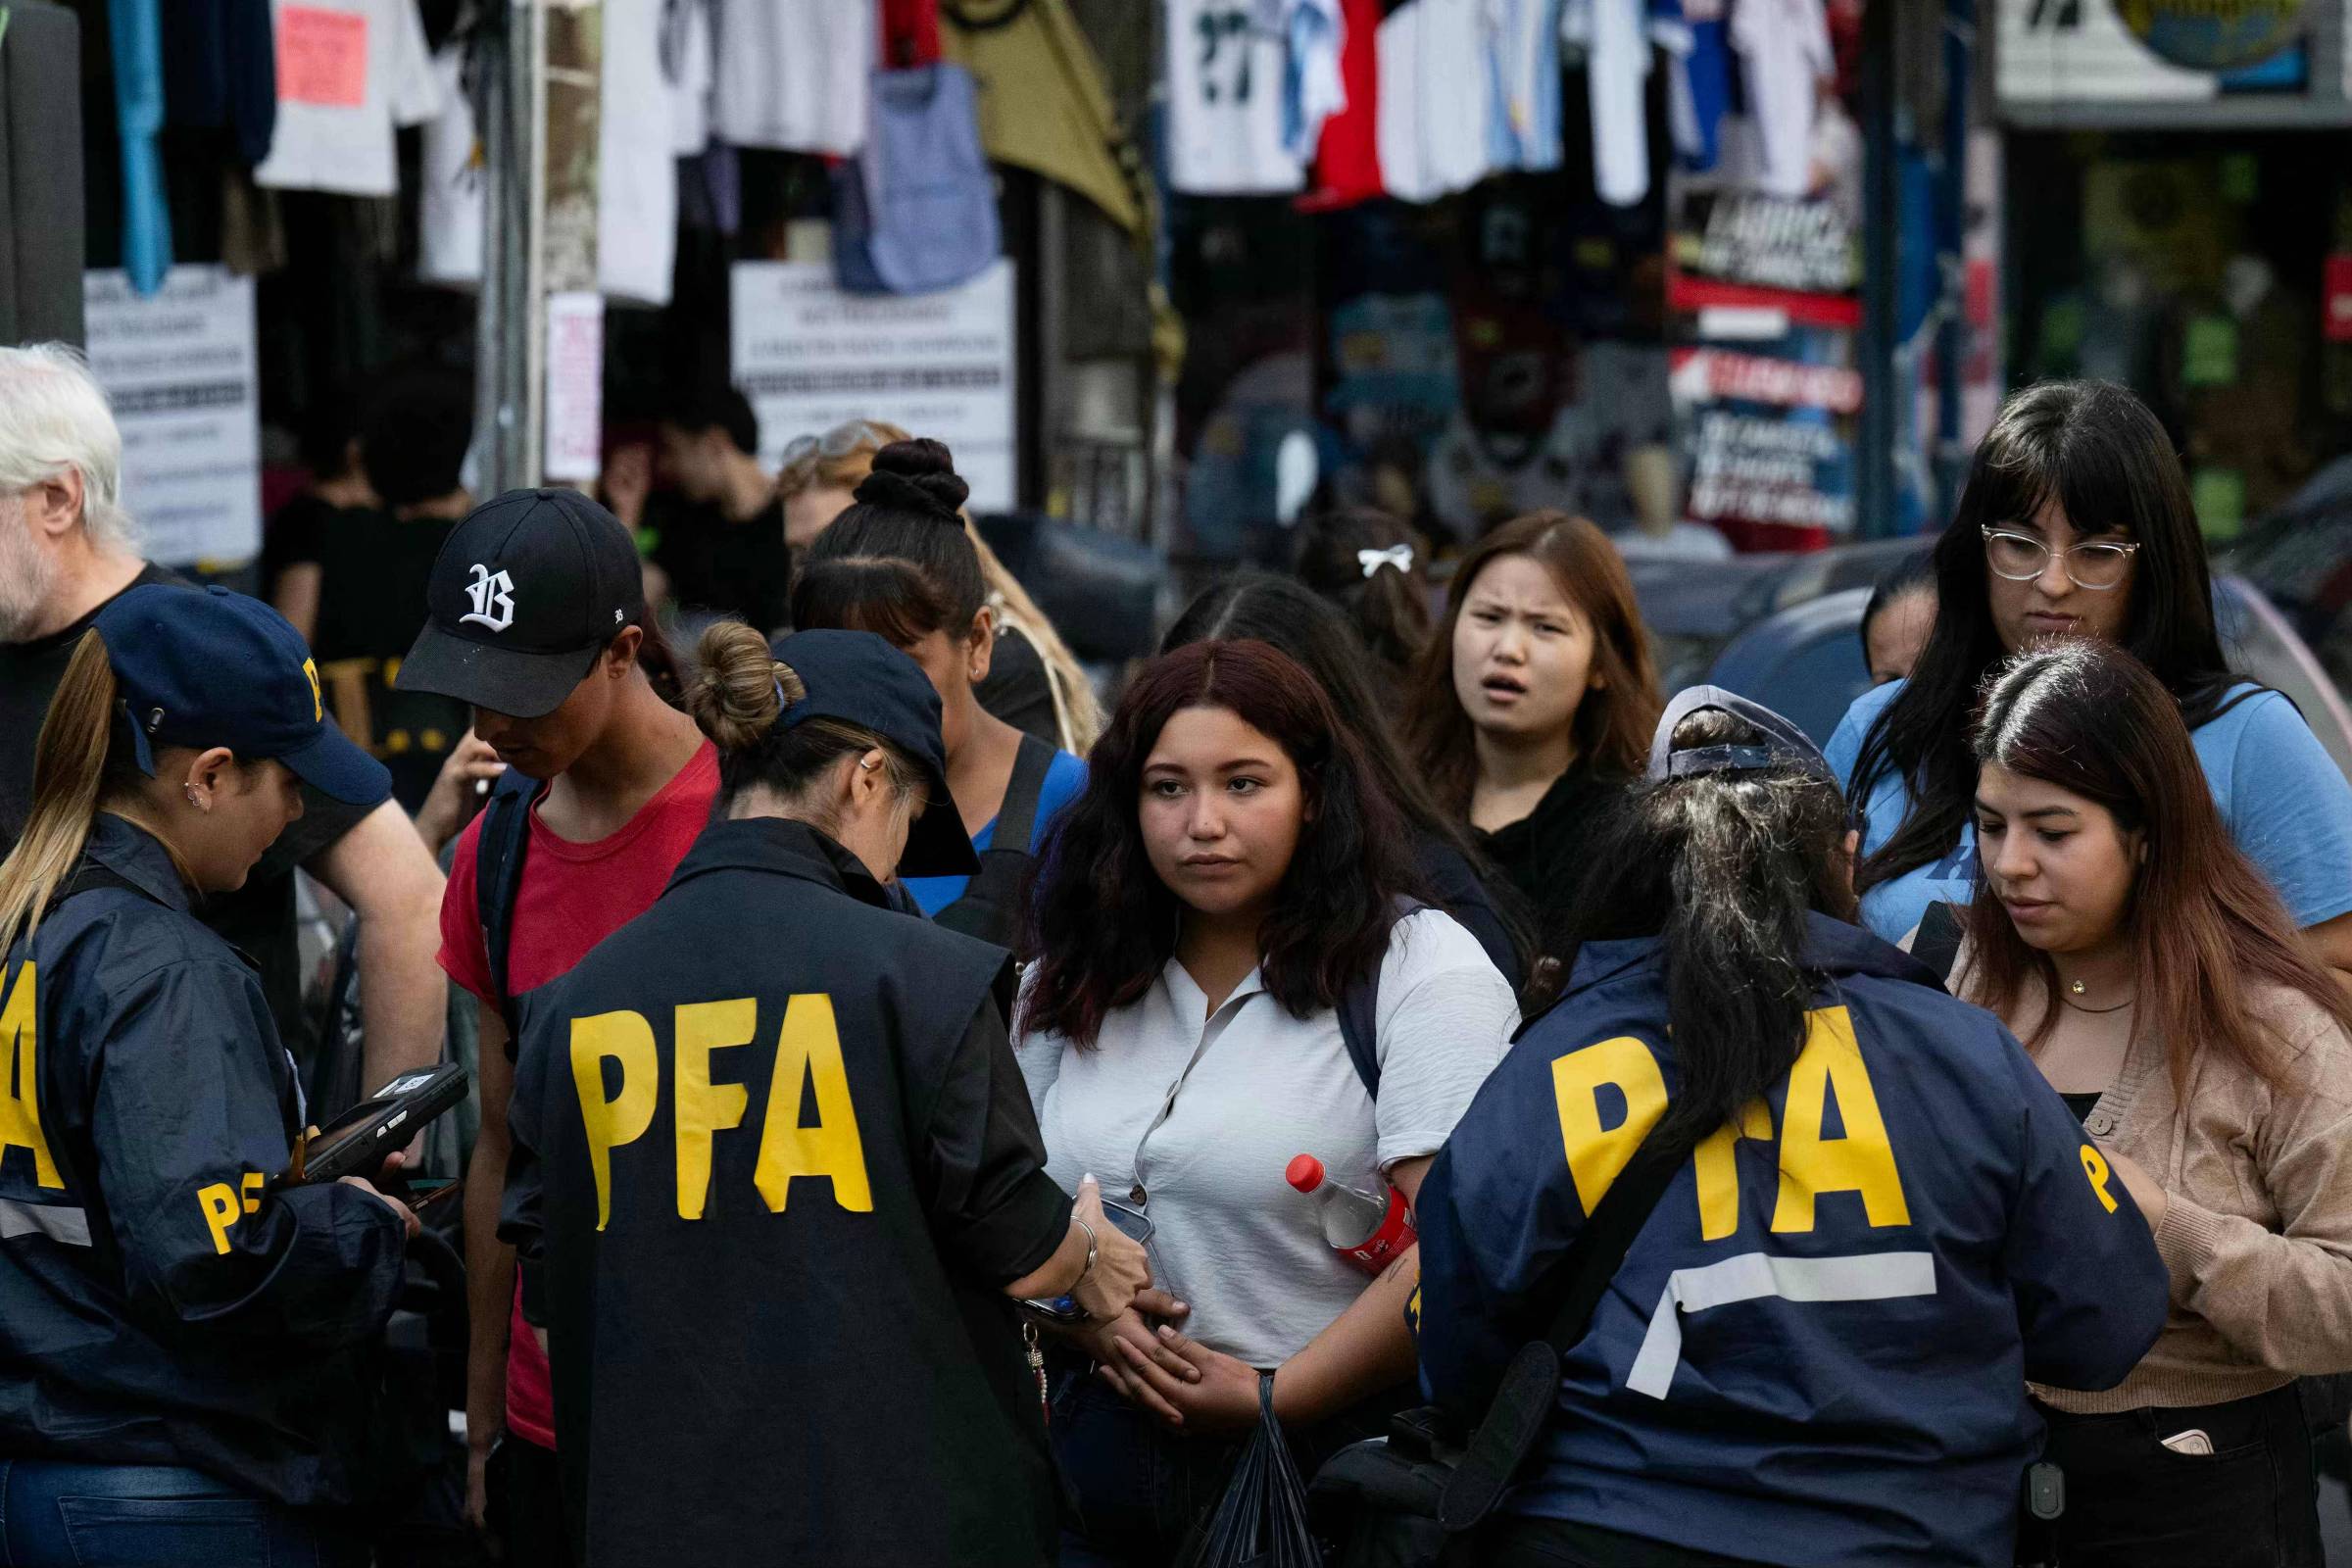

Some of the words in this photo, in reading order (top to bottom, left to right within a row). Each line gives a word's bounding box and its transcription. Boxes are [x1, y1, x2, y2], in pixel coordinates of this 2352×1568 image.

[459, 563, 515, 633] B
[569, 993, 874, 1232] PFA
[2080, 1144, 2120, 1214] P
